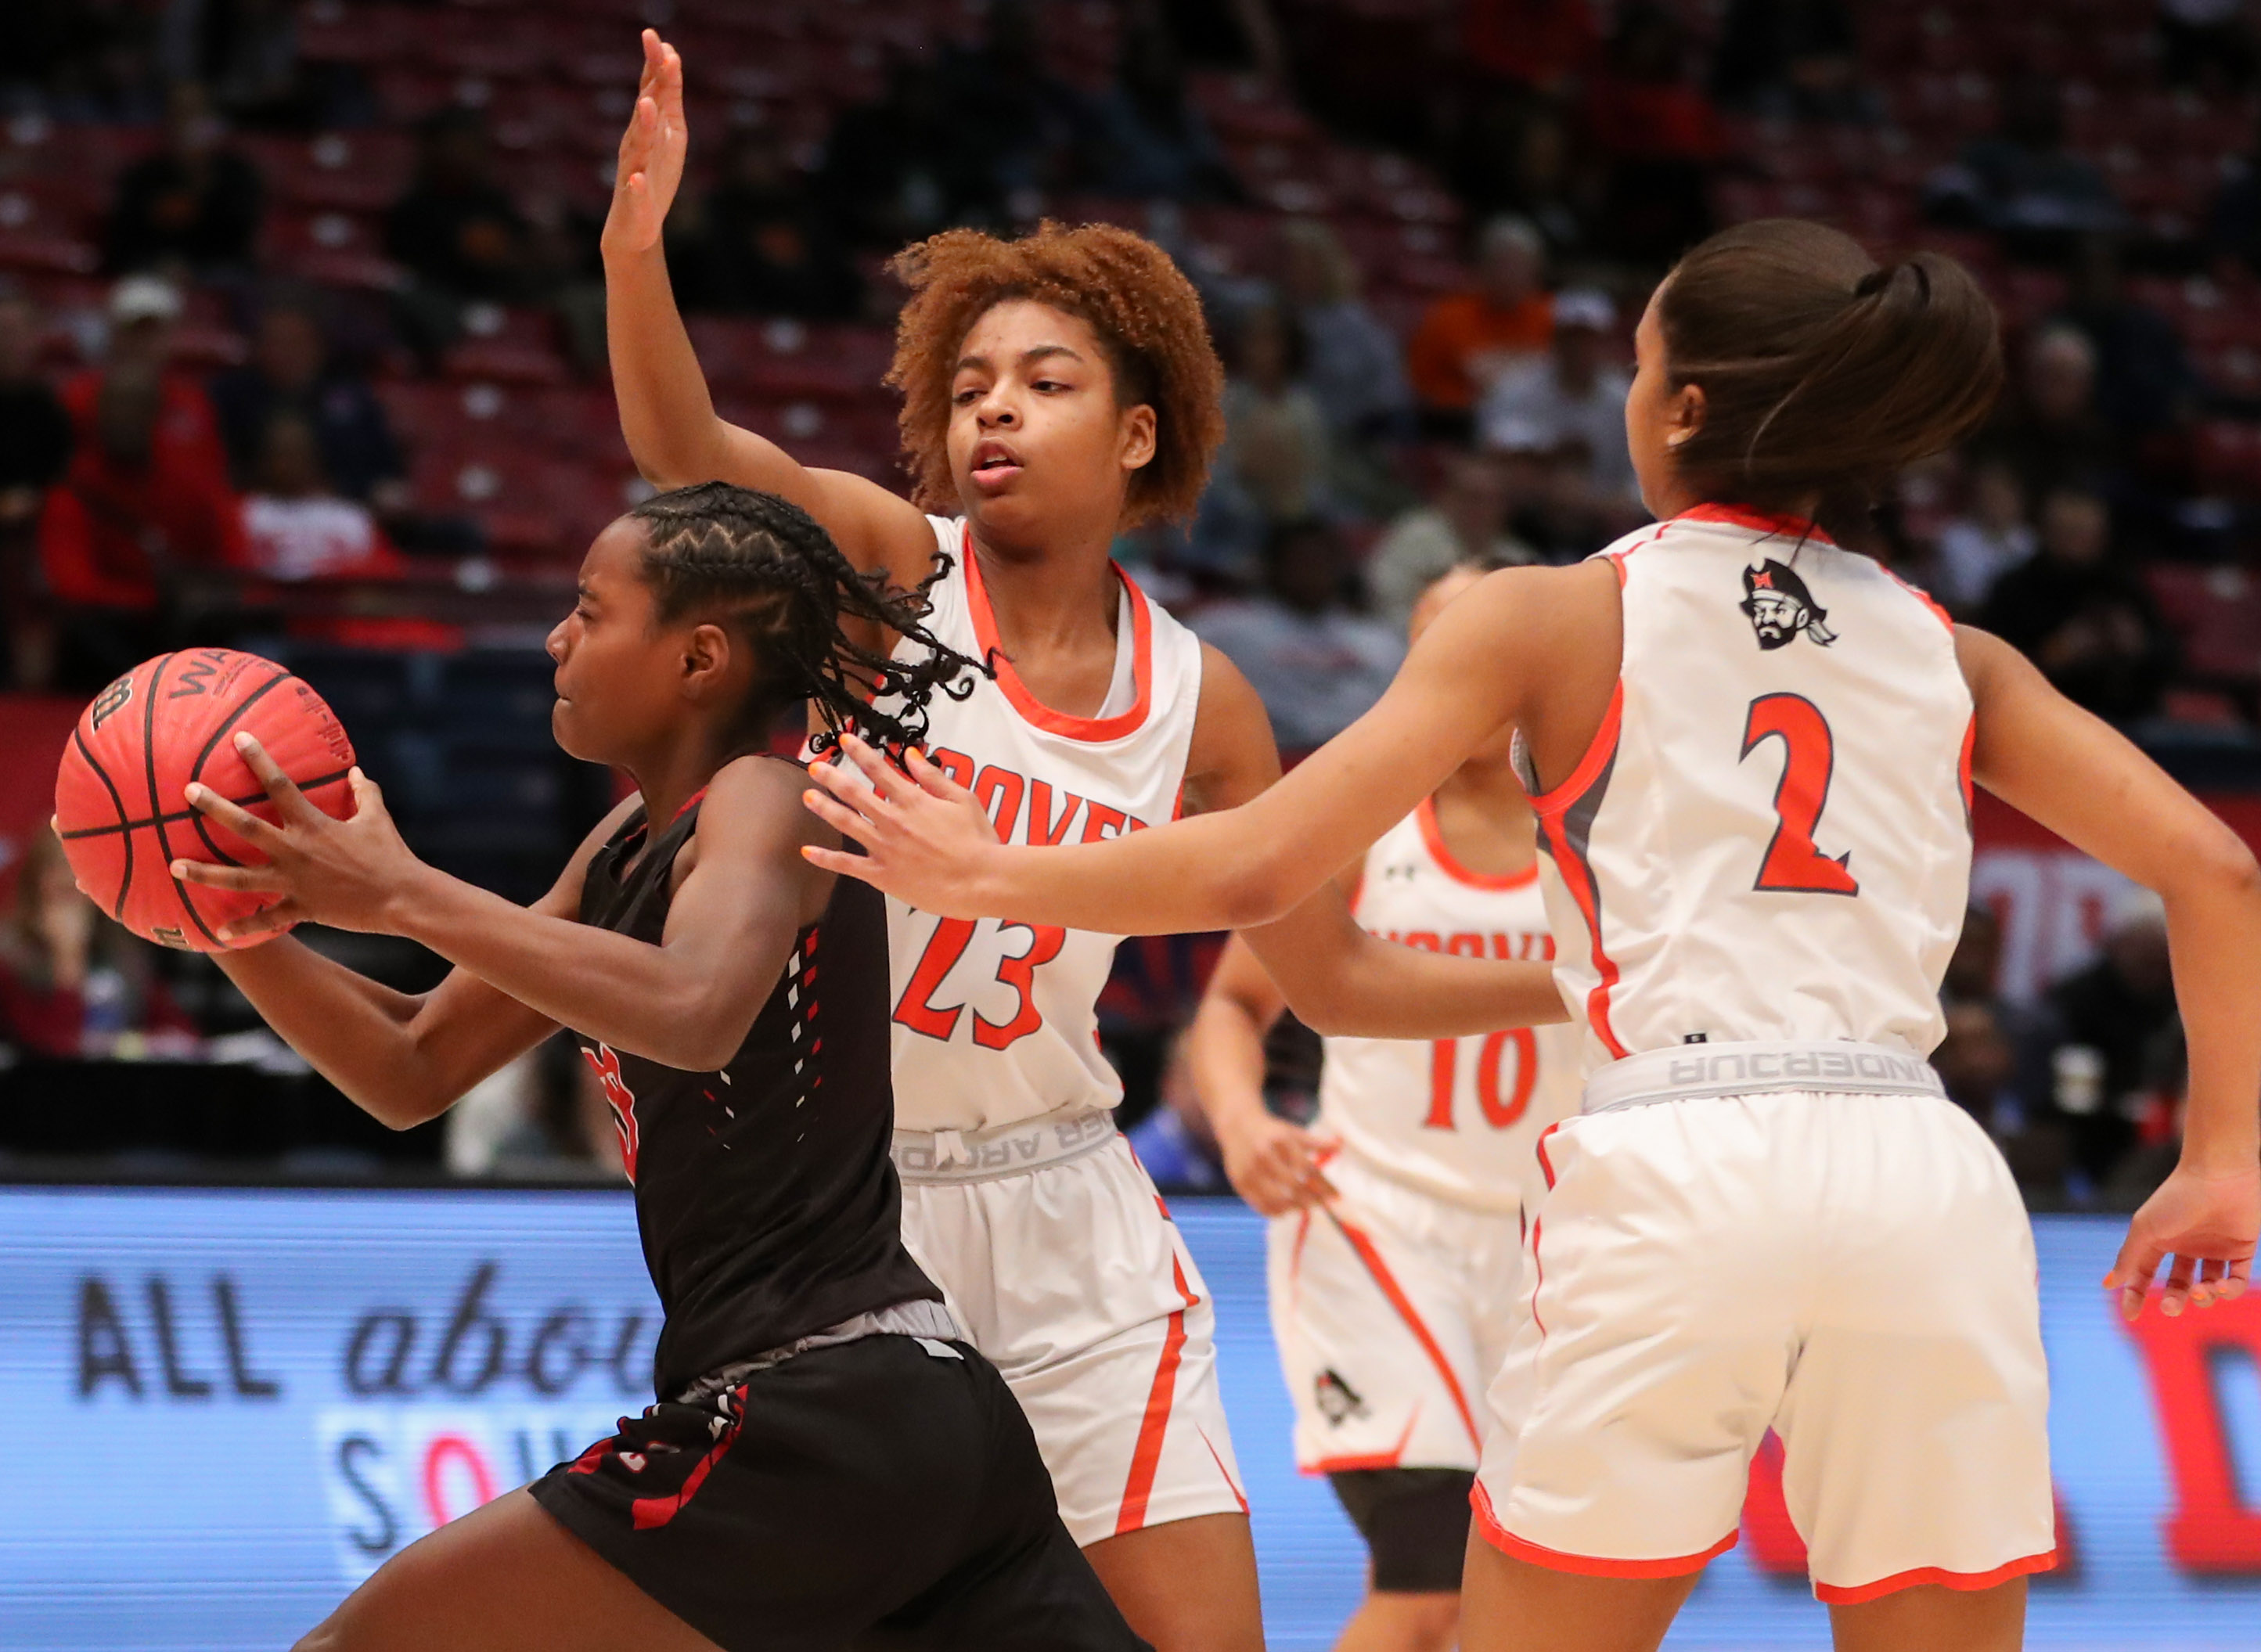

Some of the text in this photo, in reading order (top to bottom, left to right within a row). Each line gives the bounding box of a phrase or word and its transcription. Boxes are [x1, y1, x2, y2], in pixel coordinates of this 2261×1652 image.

[1739, 692, 1859, 898] 2
[891, 906, 1066, 1051] 23
[1420, 1028, 1539, 1129] 10
[74, 1271, 281, 1398] ALL
